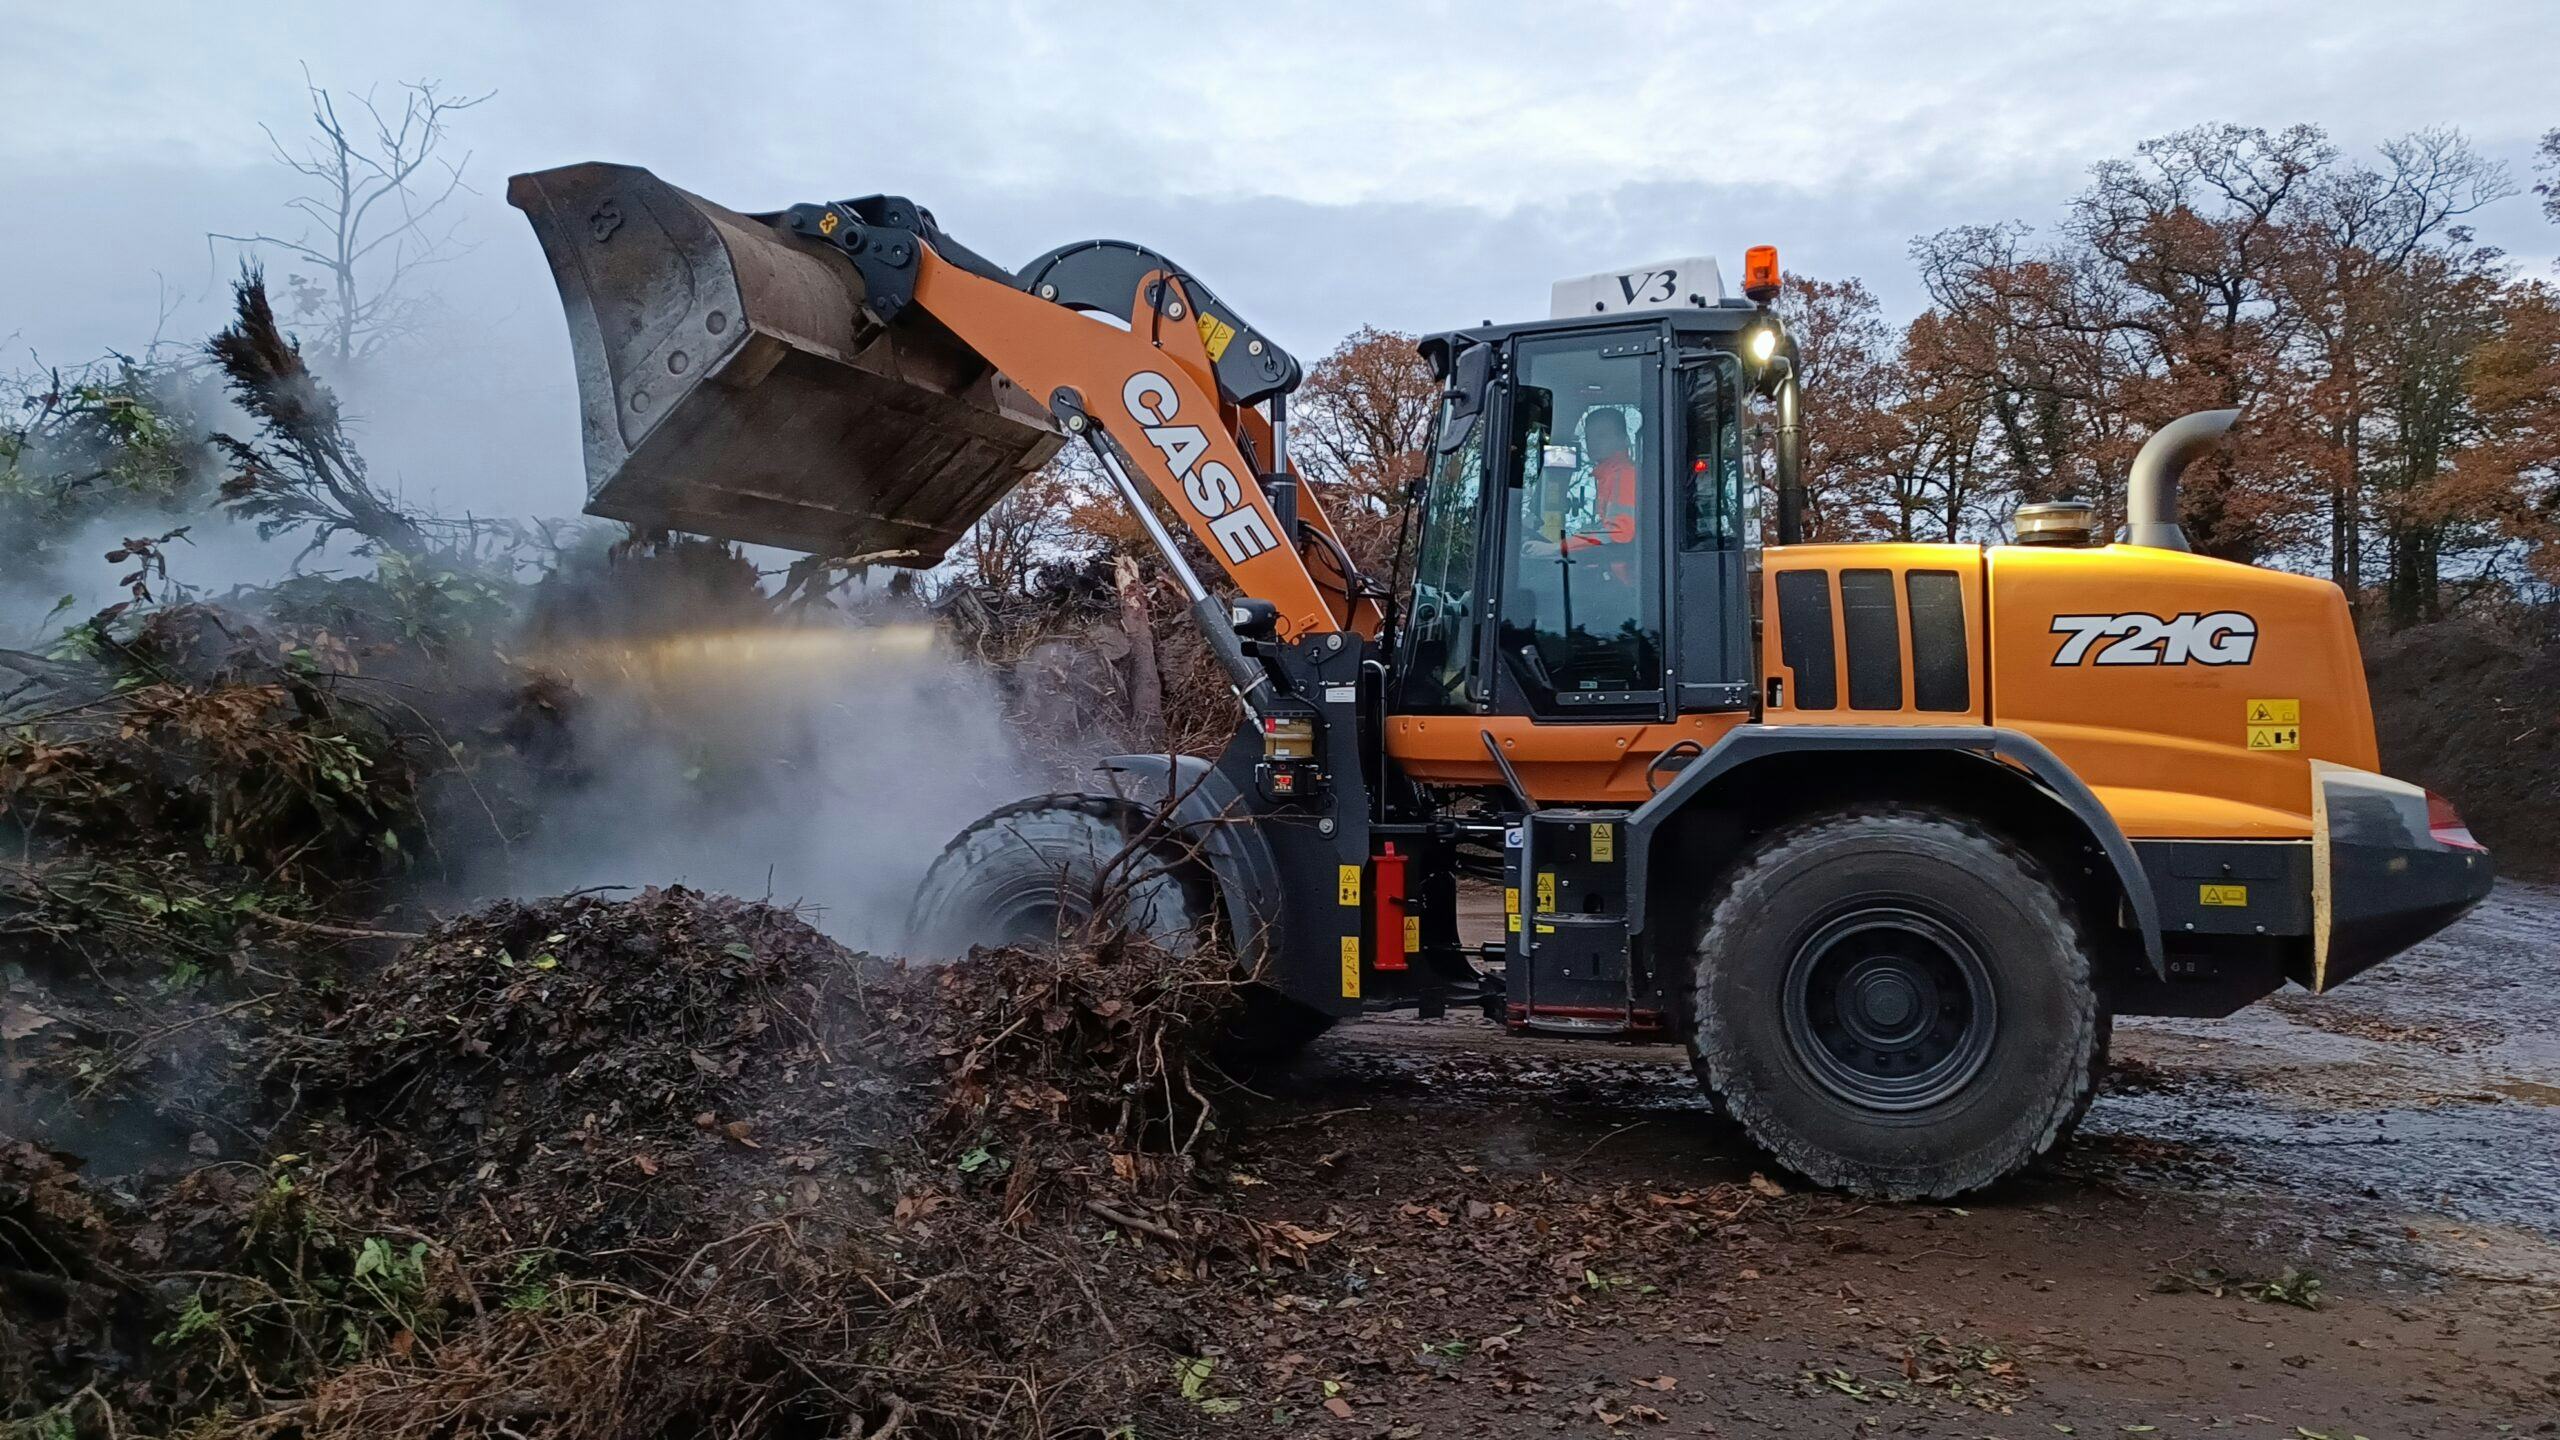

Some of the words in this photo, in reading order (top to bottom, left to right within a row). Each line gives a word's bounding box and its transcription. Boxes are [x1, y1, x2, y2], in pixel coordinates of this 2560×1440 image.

[1616, 269, 1677, 305] V3
[1122, 370, 1281, 565] CASE
[2049, 610, 2258, 666] 721G
